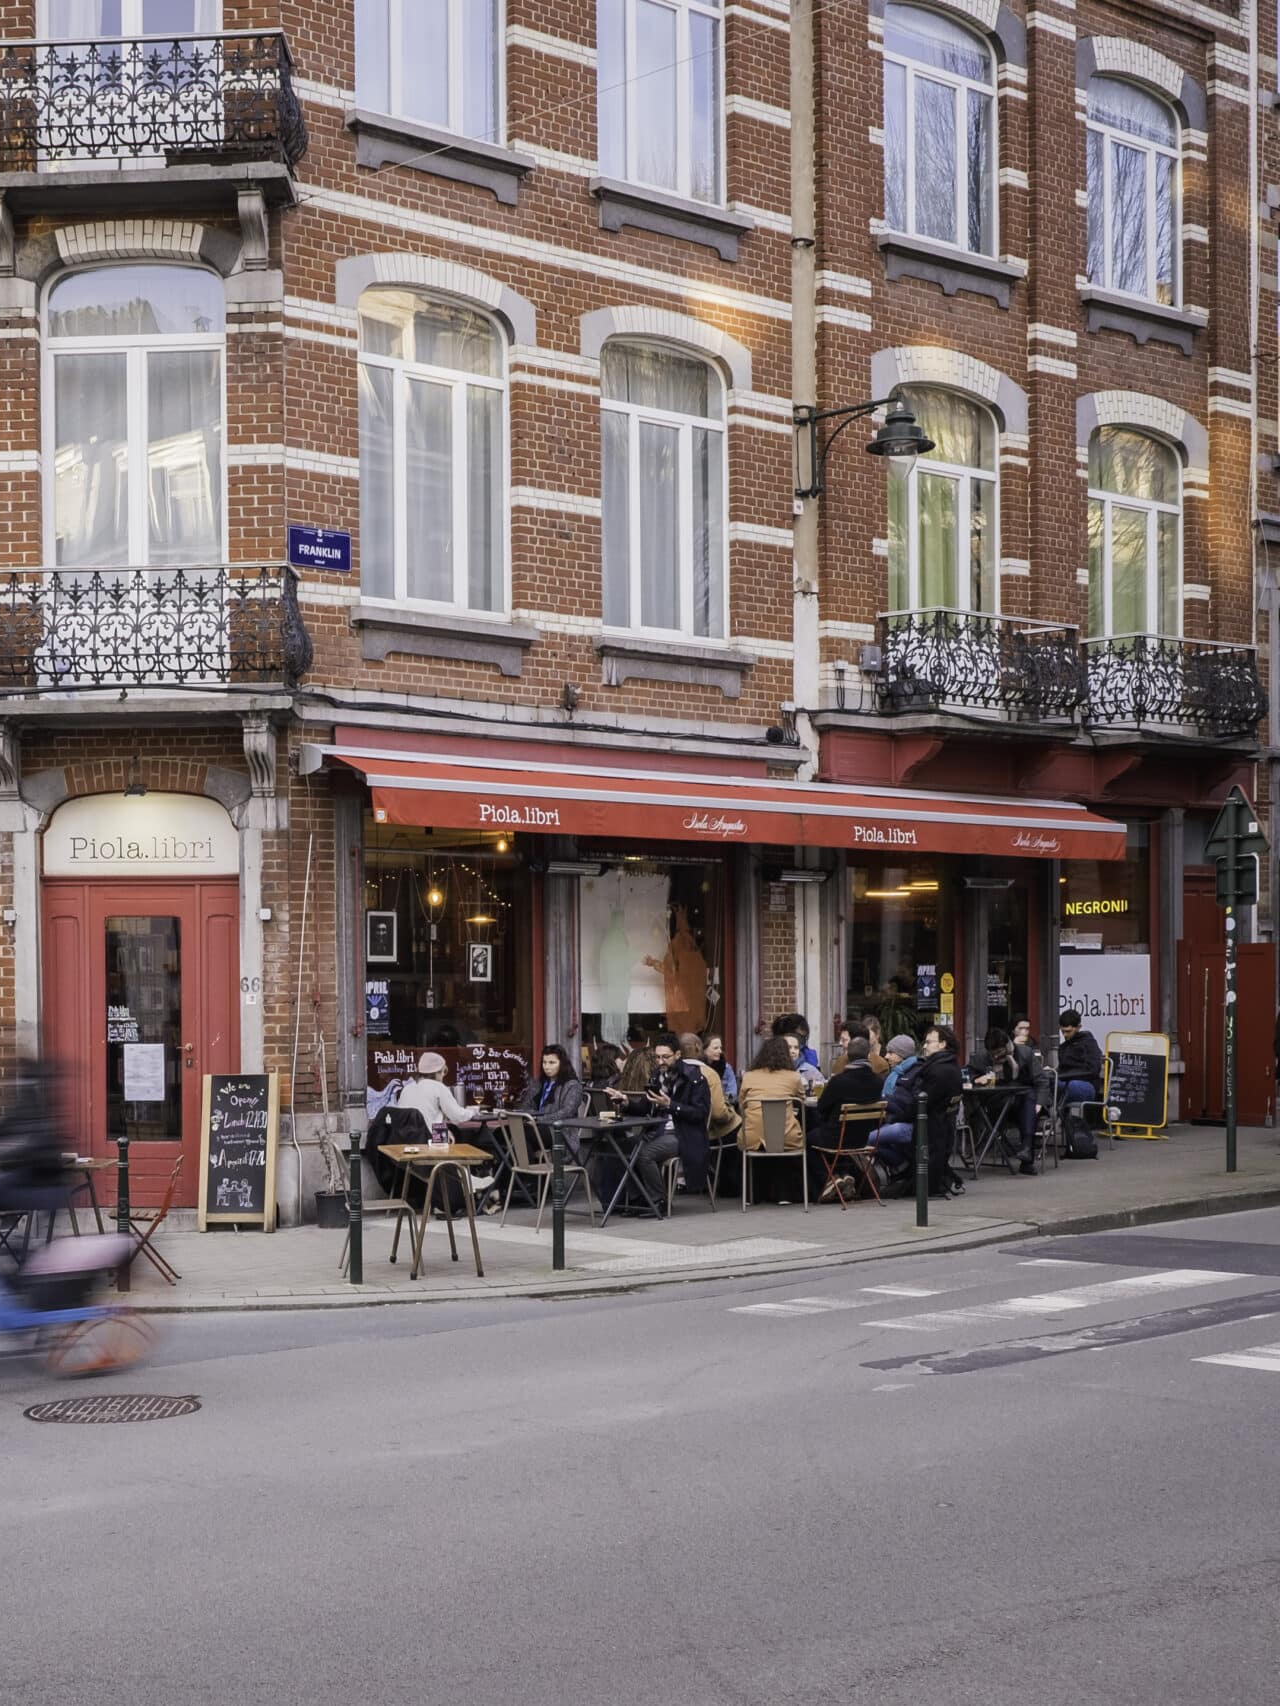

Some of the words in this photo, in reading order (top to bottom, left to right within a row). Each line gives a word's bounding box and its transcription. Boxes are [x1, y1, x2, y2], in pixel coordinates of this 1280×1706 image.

[298, 543, 341, 560] FRANKLIN
[479, 803, 561, 826] Piola.libri
[853, 825, 918, 845] Piola.libri
[69, 836, 216, 860] Piola.libri
[240, 976, 261, 993] 66
[365, 981, 389, 994] PRIL
